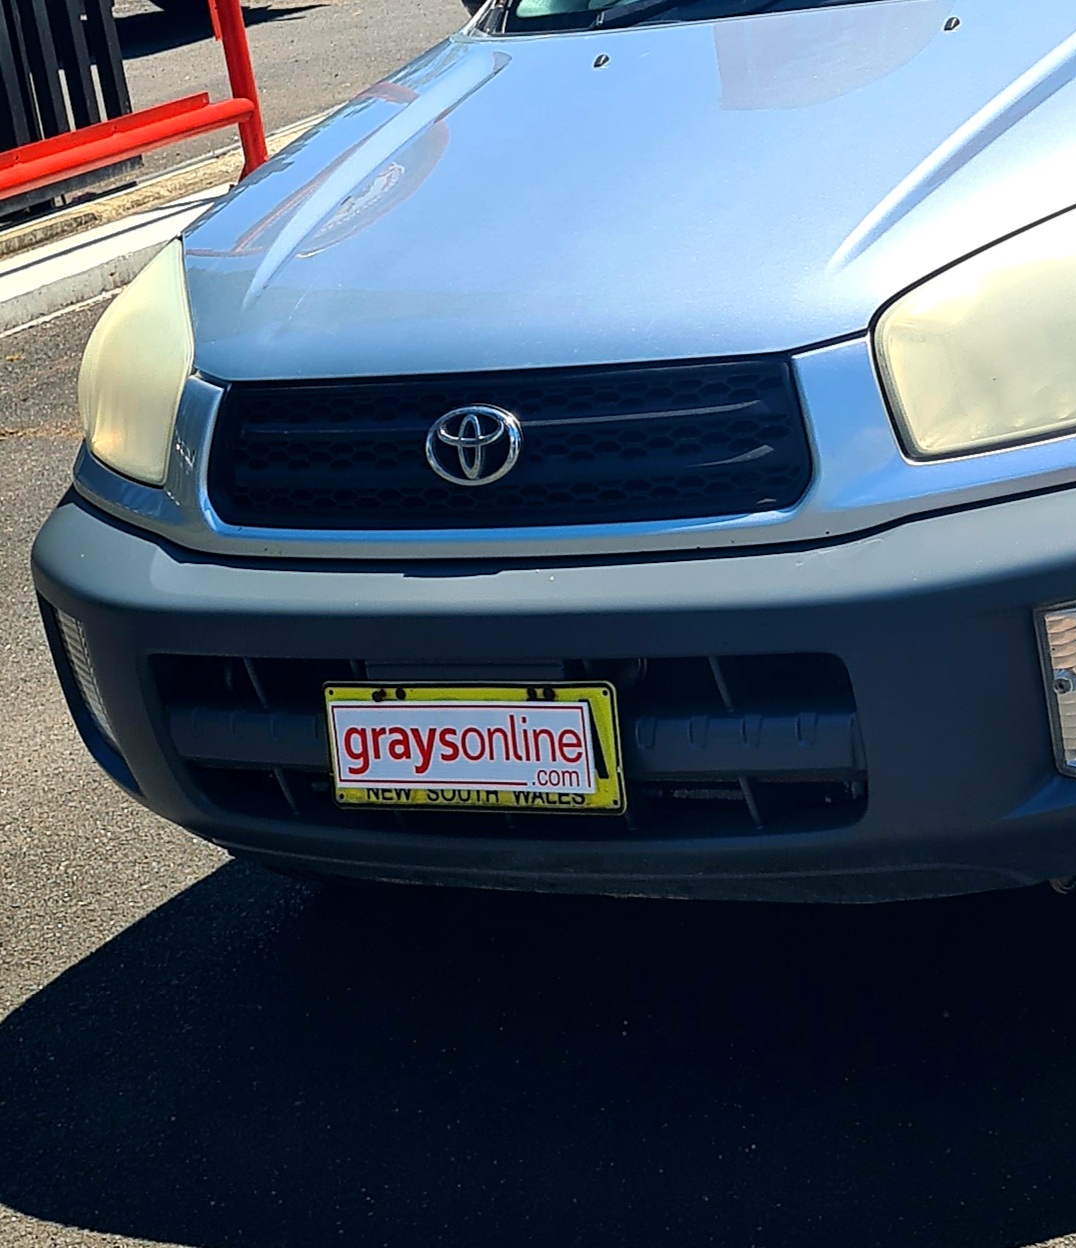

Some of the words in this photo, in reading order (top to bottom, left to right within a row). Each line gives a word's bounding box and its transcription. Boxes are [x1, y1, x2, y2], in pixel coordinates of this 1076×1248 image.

[343, 714, 583, 775] graysonline
[531, 768, 580, 787] .com
[365, 788, 413, 802] NEW
[426, 788, 500, 803] SOUTH
[513, 790, 587, 806] WALES
